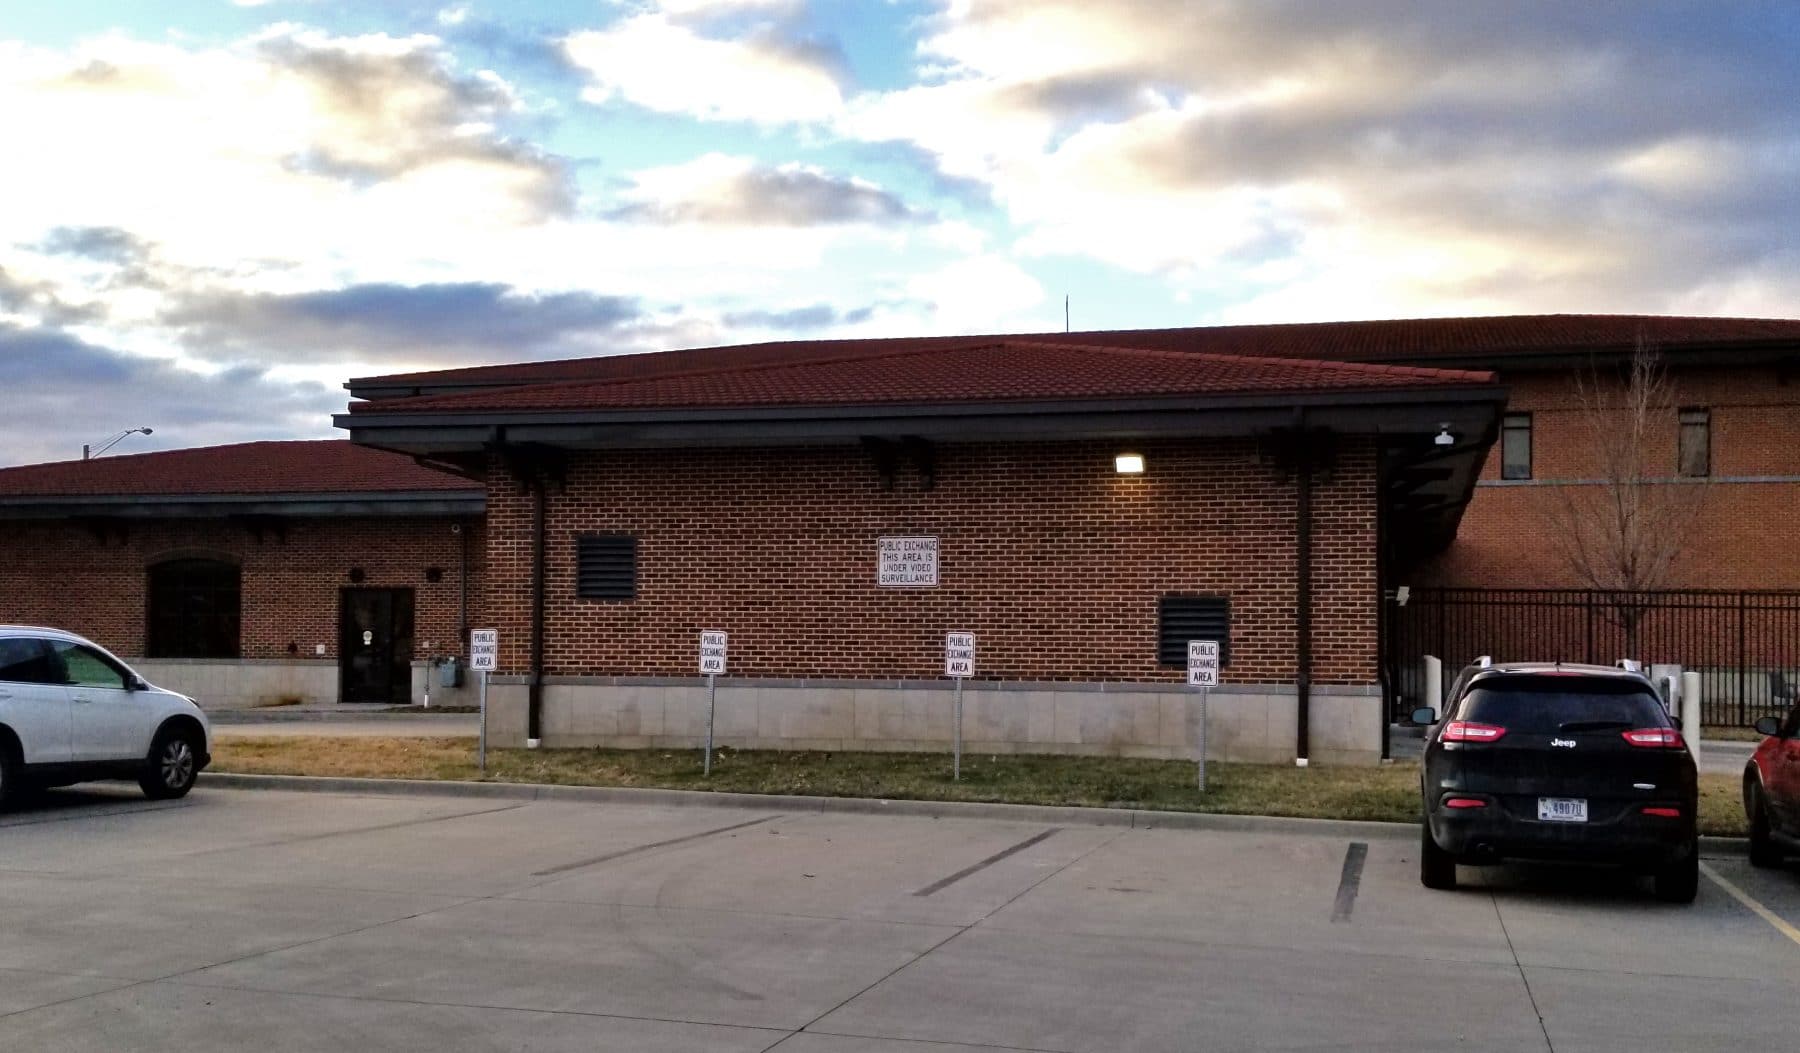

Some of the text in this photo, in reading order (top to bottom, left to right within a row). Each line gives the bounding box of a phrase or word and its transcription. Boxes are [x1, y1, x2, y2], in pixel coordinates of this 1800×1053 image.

[880, 541, 936, 551] PUBLIC EXCHANGE
[883, 553, 933, 561] THIS AREA IS
[884, 564, 931, 572] UNDER VIDEO
[881, 574, 934, 583] SURVEILLANCE
[474, 633, 494, 642] PUBLIC
[703, 635, 723, 645] PUBLIC
[949, 637, 971, 646] PUBLIC
[1191, 646, 1214, 655] PUBLIC
[475, 657, 491, 666] AREA
[704, 660, 720, 669] AREA
[951, 663, 968, 672] AREA
[1193, 672, 1212, 681] AREA
[1551, 738, 1576, 748] Jeep
